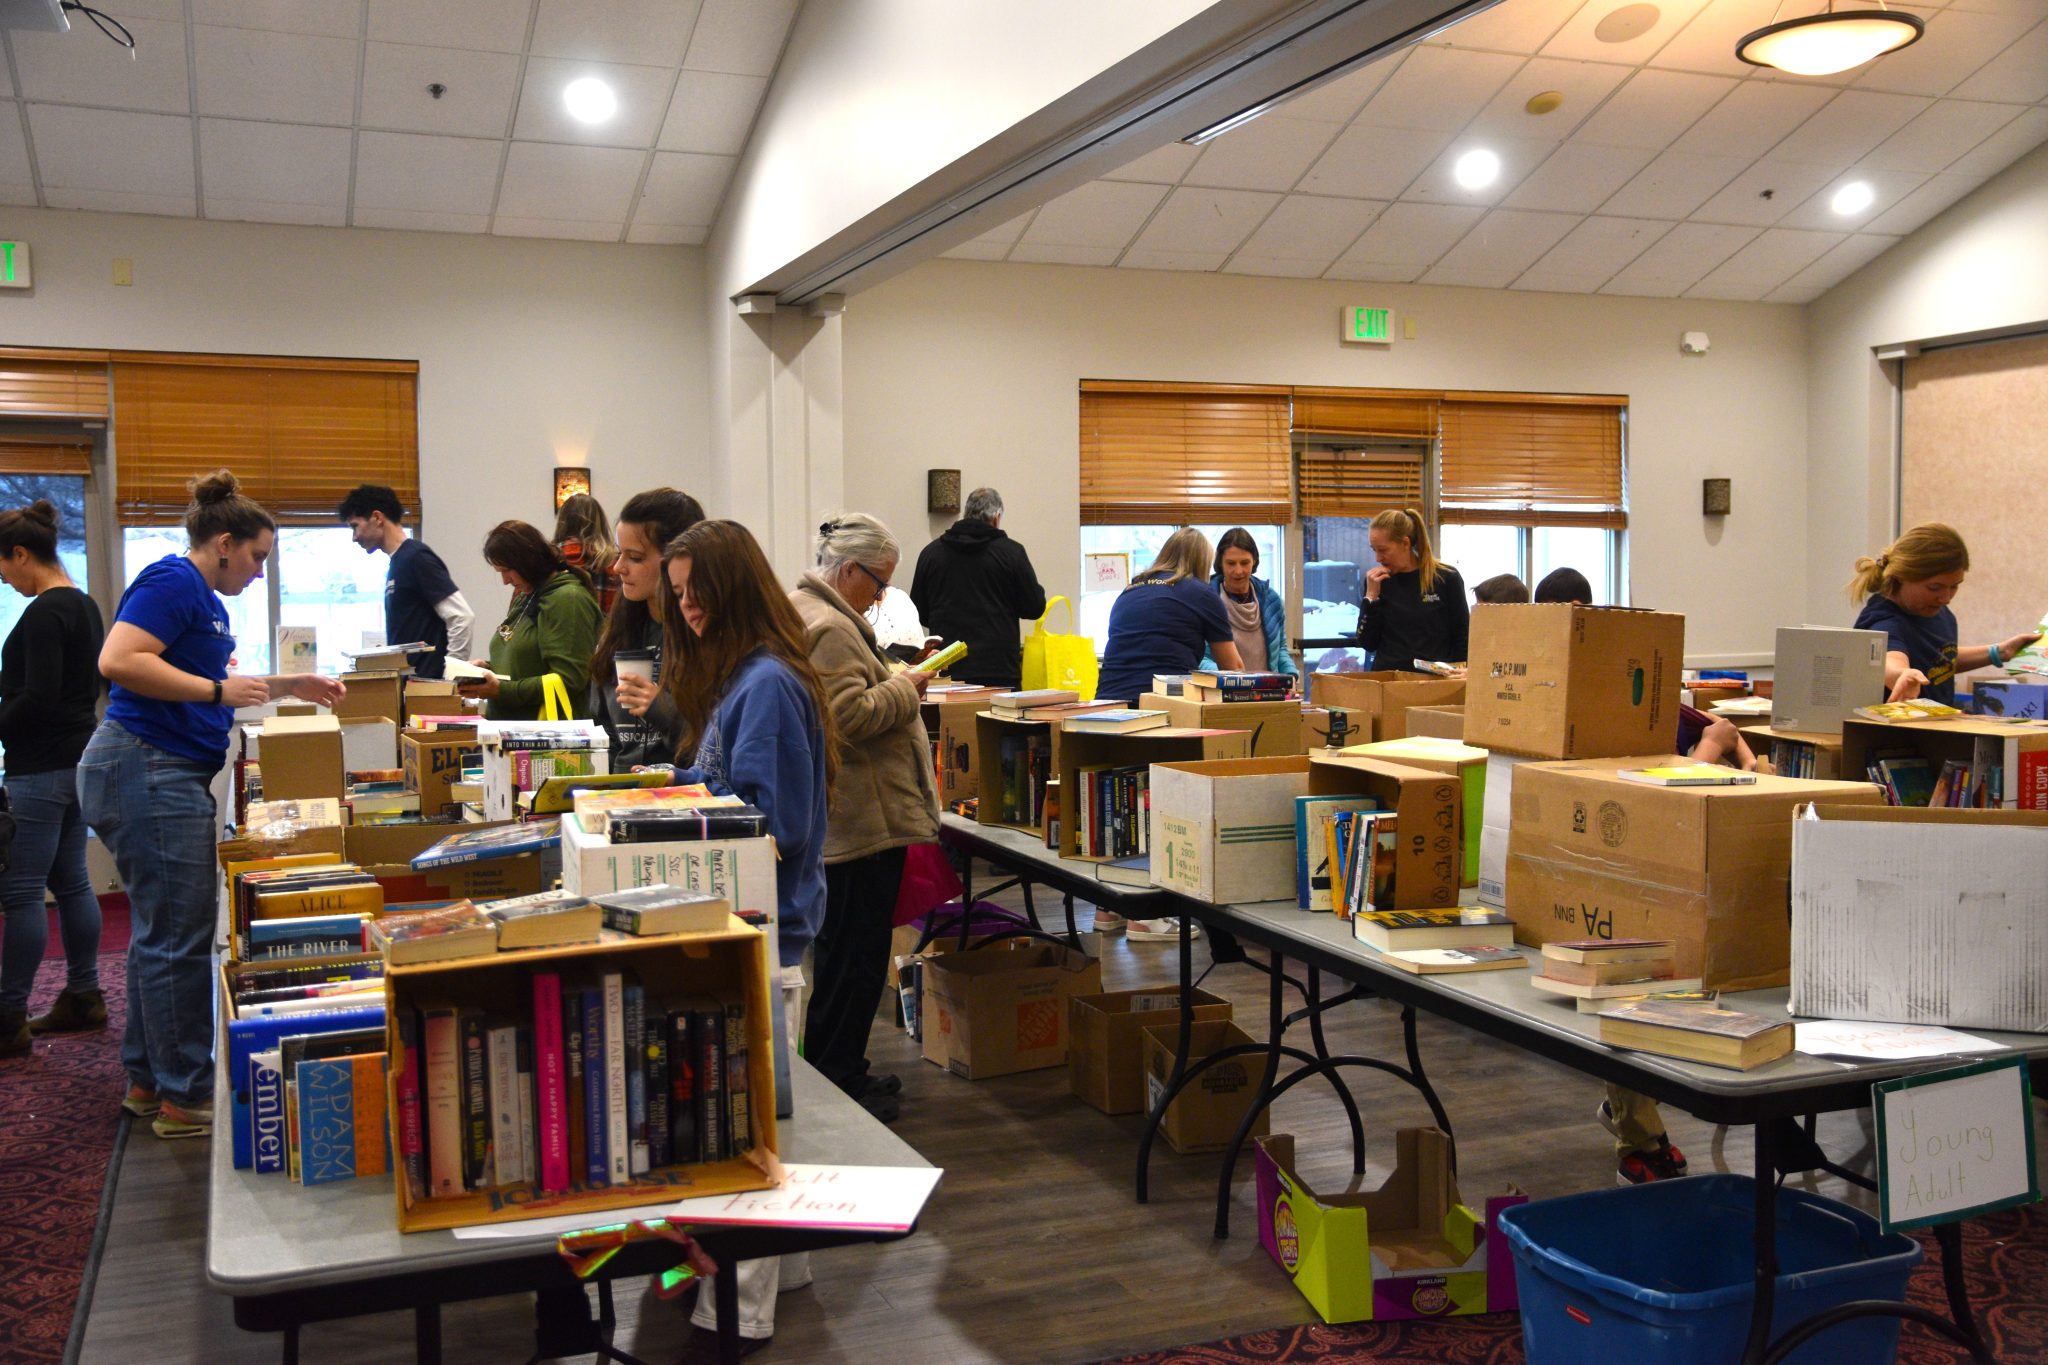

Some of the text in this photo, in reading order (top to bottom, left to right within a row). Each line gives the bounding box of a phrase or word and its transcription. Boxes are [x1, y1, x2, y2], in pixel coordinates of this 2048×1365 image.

[1355, 307, 1389, 339] EXIT
[1223, 676, 1256, 688] Tom Clancy
[618, 732, 650, 743] SSICAL
[520, 759, 528, 785] Organic
[2035, 765, 2047, 789] COPY
[417, 853, 477, 870] SONGS OF THE WILD WEST
[669, 856, 681, 877] SSC
[712, 849, 728, 880] MARK'S
[1166, 841, 1174, 879] 1
[298, 894, 347, 913] ALICE
[1553, 903, 1612, 940] PA BNN
[266, 939, 349, 959] THE RIVER
[607, 984, 618, 1014] TWO
[586, 1006, 600, 1060] Worthy
[547, 1053, 556, 1073] NOT
[610, 1040, 620, 1063] FAR
[549, 1088, 558, 1119] HAPPY
[591, 1070, 600, 1112] CATHERINE
[610, 1066, 623, 1114] NORTH
[257, 1065, 281, 1169] ember
[309, 1064, 332, 1180] WILSON
[328, 1064, 355, 1176] ADAM
[592, 1114, 600, 1133] RYAN
[405, 1088, 418, 1179] HER PERFECT FAMILY
[551, 1124, 560, 1158] FAMILY
[1900, 1105, 1994, 1163] Young
[1905, 1161, 1966, 1211] Adult
[723, 1193, 857, 1213] Fiction
[1416, 1278, 1446, 1286] KIRKLAND
